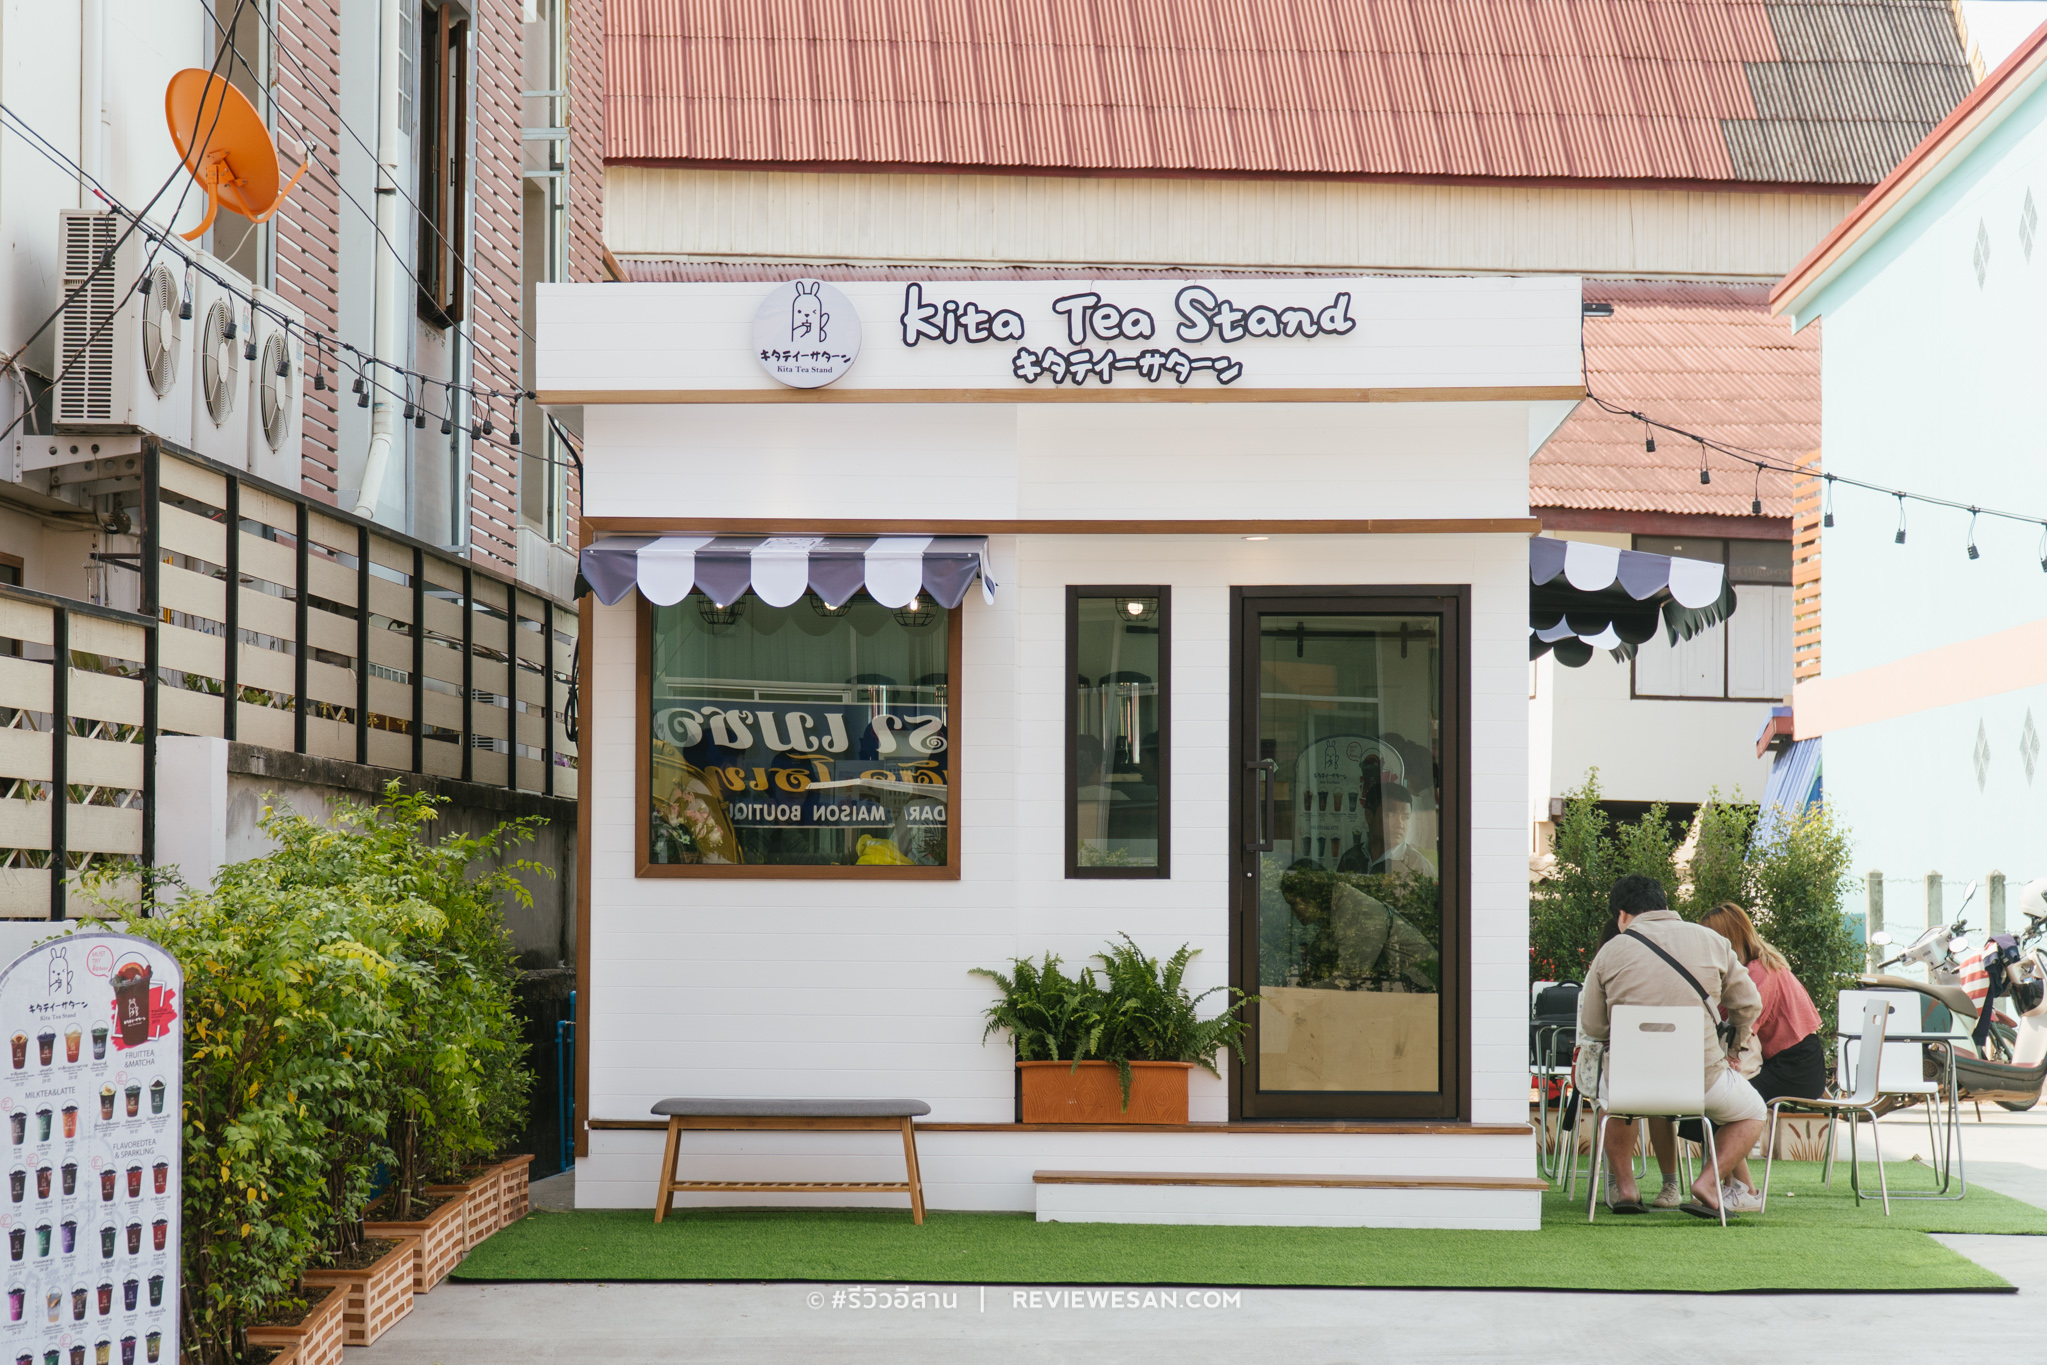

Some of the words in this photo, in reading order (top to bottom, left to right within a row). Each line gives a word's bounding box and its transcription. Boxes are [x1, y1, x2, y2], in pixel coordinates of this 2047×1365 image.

[1052, 292, 1154, 345] Tea
[1175, 285, 1356, 344] Stand
[125, 1050, 154, 1058] FRUITTEA
[124, 1059, 155, 1068] &MATCHA
[25, 1087, 76, 1099] MILKTEA&LATTE
[113, 1139, 156, 1150] FLAVOREDTEA
[121, 1147, 155, 1158] SPARKLING
